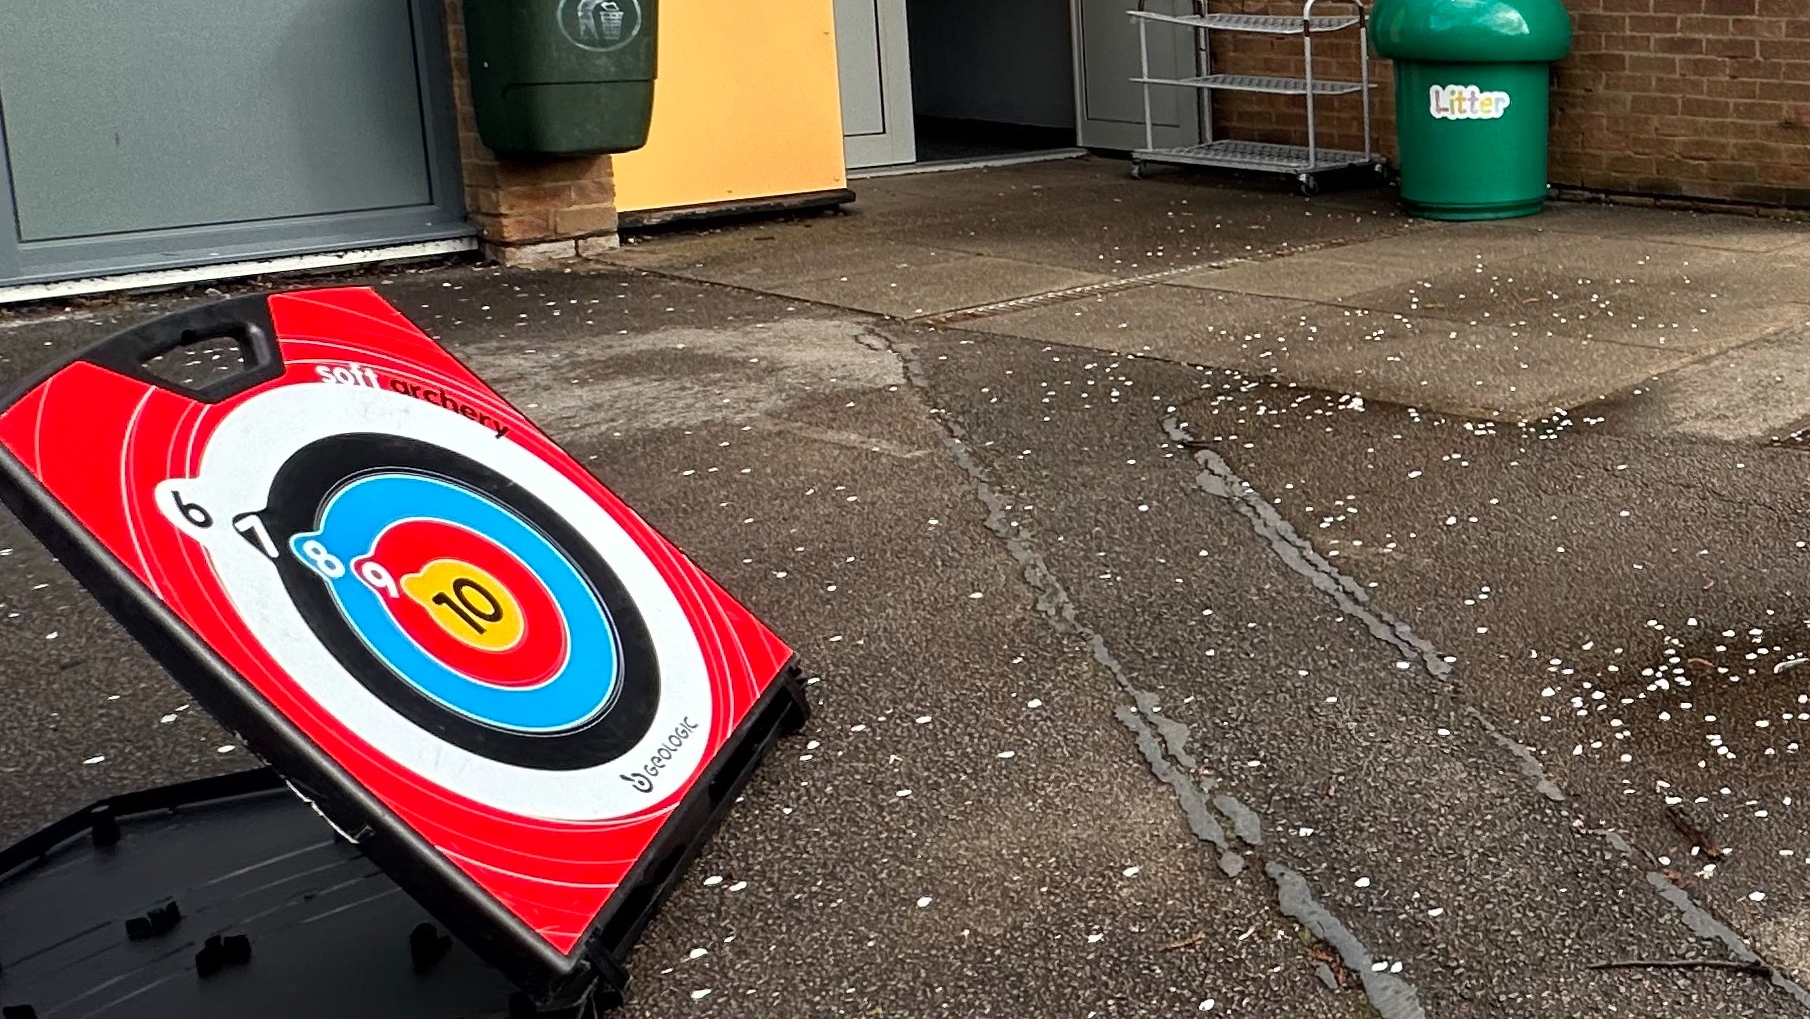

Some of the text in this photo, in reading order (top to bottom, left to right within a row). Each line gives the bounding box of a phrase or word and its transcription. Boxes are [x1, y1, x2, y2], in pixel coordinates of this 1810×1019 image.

[1434, 88, 1507, 116] Litter
[315, 362, 509, 439] soft archery
[171, 490, 503, 635] 6 7 8 9 10
